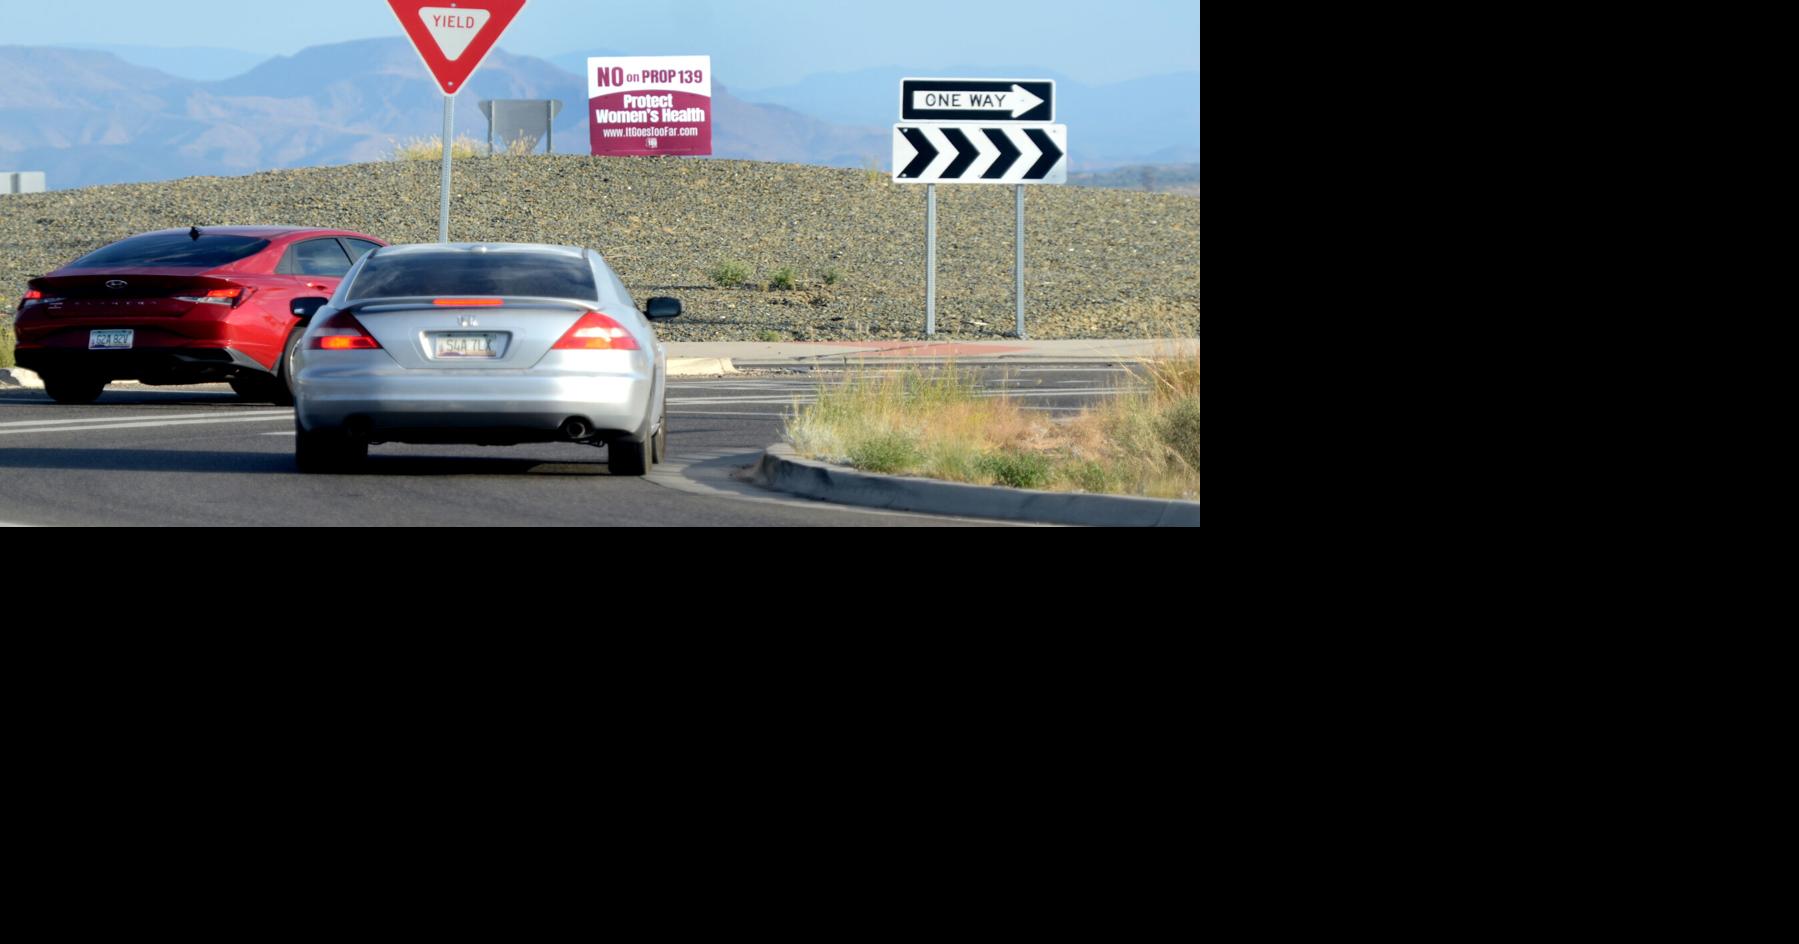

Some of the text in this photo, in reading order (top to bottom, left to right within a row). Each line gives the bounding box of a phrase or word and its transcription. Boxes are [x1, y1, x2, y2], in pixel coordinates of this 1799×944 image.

[433, 15, 475, 28] YIELD
[597, 67, 703, 87] NO on PROP 139
[623, 94, 673, 109] Protect
[925, 93, 1006, 108] ONE WAY
[595, 107, 705, 124] Women's Health
[603, 126, 698, 138] www.ItGoesTooFar.com
